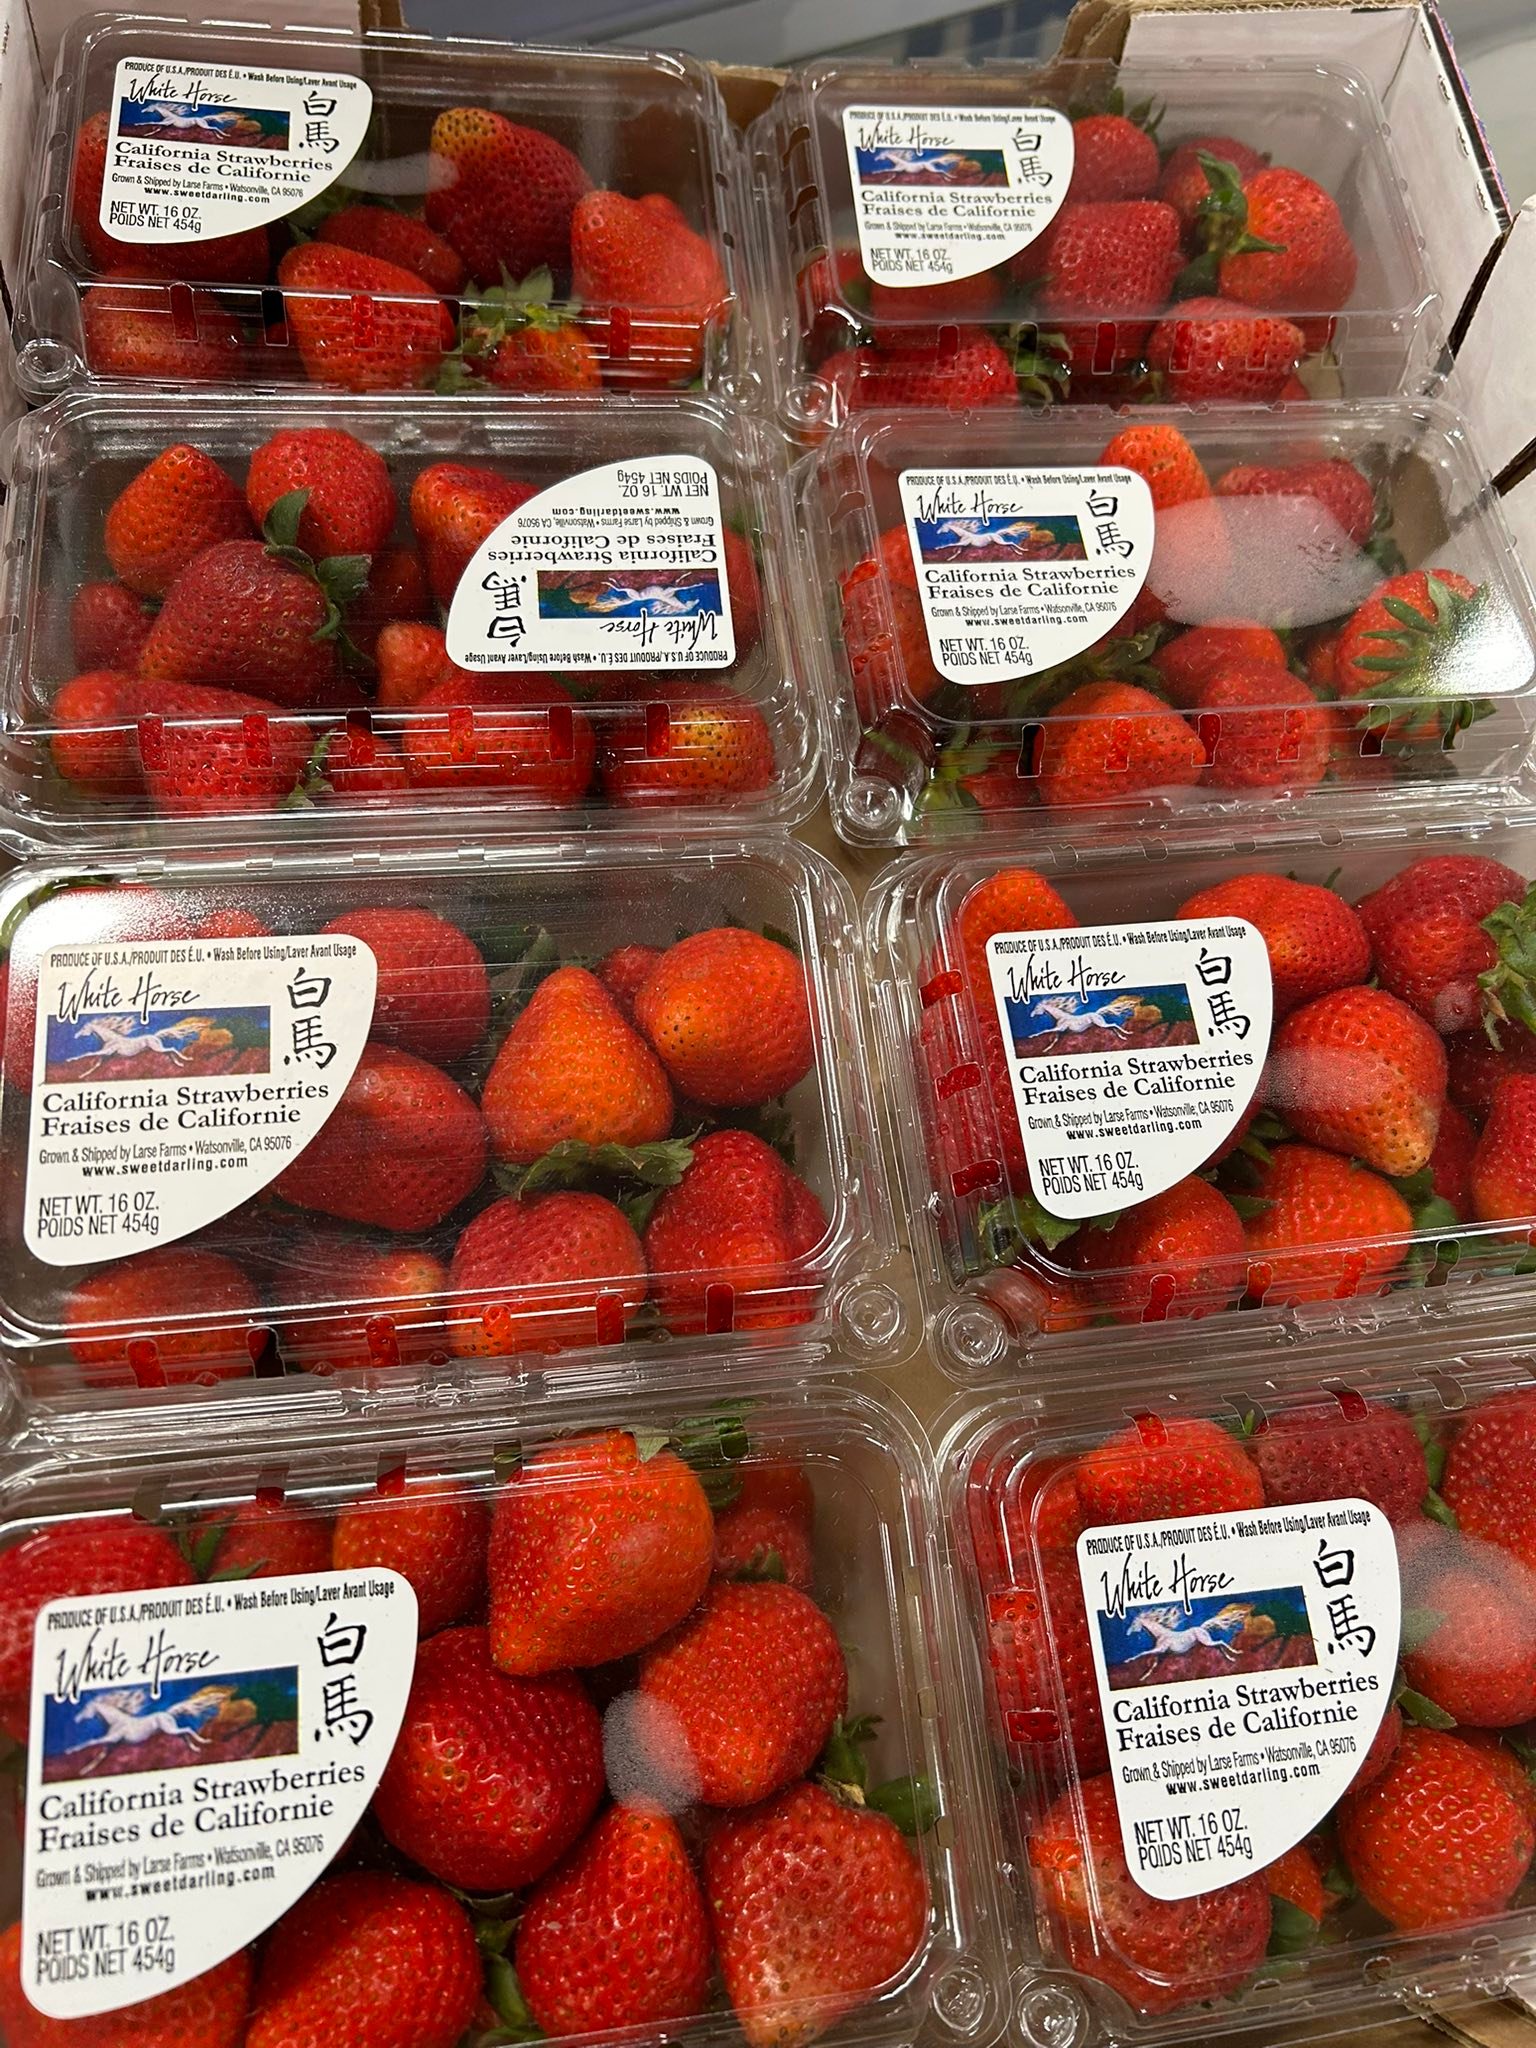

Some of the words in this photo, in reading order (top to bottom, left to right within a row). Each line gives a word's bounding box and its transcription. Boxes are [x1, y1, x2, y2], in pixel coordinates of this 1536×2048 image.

[129, 72, 179, 104] White
[182, 79, 238, 111] Horse
[858, 120, 904, 152] White
[906, 124, 955, 155] Horse
[113, 154, 182, 172] Fraises
[187, 161, 211, 175] de
[216, 163, 312, 183] Californie
[116, 141, 211, 161] California
[216, 149, 334, 172] Strawberries
[144, 184, 270, 204] www.sweetdarling.com
[860, 190, 946, 203] California
[949, 191, 1053, 205] Strawberries
[109, 212, 145, 228] POIDS
[147, 215, 171, 230] NET
[173, 218, 202, 235] 454g
[110, 200, 137, 215] NET
[138, 202, 160, 217] WT.
[163, 205, 179, 218] 16
[182, 206, 202, 220] OZ.
[861, 203, 923, 216] Fraises
[927, 204, 948, 217] de
[952, 204, 1037, 218] Californie
[870, 247, 892, 261] NET
[893, 248, 914, 261] WT.
[916, 248, 931, 261] 16
[932, 248, 952, 261] OZ.
[871, 259, 904, 272] POIDS
[904, 259, 925, 272] NET
[928, 260, 954, 275] 454g
[616, 469, 645, 485] 454g
[648, 472, 671, 485] NET
[673, 471, 708, 485] POIDS
[617, 484, 639, 498] OZ.
[641, 484, 658, 498] 16
[660, 484, 684, 498] WT.
[684, 484, 710, 498] NET
[551, 506, 681, 518] www.sweetdarling.com
[916, 486, 967, 524] White
[970, 489, 1024, 525] Horse
[510, 535, 611, 550] Californie
[616, 535, 641, 549] de
[646, 534, 717, 549] Fraises
[487, 550, 613, 565] Strawberries
[618, 549, 718, 564] California
[924, 568, 1019, 584] California
[1022, 565, 1136, 581] Strawberries
[926, 584, 995, 600] Fraises
[999, 583, 1023, 598] de
[1027, 581, 1119, 597] Californie
[599, 609, 660, 648] Horse
[663, 611, 718, 651] White
[965, 615, 1088, 627] www.sweetdarling.com
[938, 638, 964, 653] NET
[964, 637, 989, 652] WT.
[990, 637, 1007, 651] 16
[1008, 636, 1030, 651] OZ.
[942, 651, 978, 668] POIDS
[978, 651, 1001, 666] NET
[1004, 650, 1034, 667] 454g
[1007, 952, 1063, 1003] White
[1066, 954, 1127, 1002] Horse
[57, 966, 123, 1022] White
[128, 970, 201, 1023] Horse
[1019, 1059, 1124, 1085] California
[1127, 1049, 1254, 1075] Strawberries
[42, 1088, 169, 1114] California
[176, 1080, 329, 1106] Strawberries
[1021, 1084, 1098, 1106] Fraises
[1103, 1080, 1129, 1099] de
[1133, 1071, 1236, 1096] Californie
[40, 1114, 131, 1138] Fraises
[139, 1111, 169, 1132] de
[177, 1104, 301, 1130] Californie
[1066, 1119, 1203, 1141] www.sweetdarling.com
[38, 1149, 70, 1166] Grown
[71, 1147, 80, 1163] &
[81, 1146, 118, 1165] Shipped
[119, 1146, 132, 1163] by
[132, 1144, 158, 1159] Larse
[159, 1142, 187, 1157] Farms
[194, 1138, 247, 1155] Watsonville,
[249, 1137, 263, 1152] CA
[264, 1135, 292, 1151] 95076
[82, 1157, 249, 1178] www.sweetdarling.com
[1038, 1157, 1065, 1178] NET
[1066, 1155, 1094, 1175] WT.
[1095, 1153, 1113, 1172] 16
[1115, 1151, 1139, 1170] OZ.
[1042, 1174, 1082, 1197] POIDS
[1082, 1172, 1108, 1192] NET
[1112, 1170, 1144, 1191] 454g
[38, 1196, 73, 1219] NET
[75, 1194, 103, 1216] WT.
[109, 1193, 129, 1213] 16
[134, 1190, 160, 1212] OZ.
[37, 1216, 84, 1240] POIDS
[89, 1214, 119, 1236] NET
[122, 1212, 160, 1236] 454g
[1085, 1535, 1124, 1556] PRODUCE
[1123, 1534, 1135, 1552] OF
[1196, 1525, 1213, 1543] DES
[1235, 1520, 1259, 1538] Wash
[1257, 1518, 1283, 1536] Before
[1281, 1514, 1326, 1534] Using/Laver
[1326, 1510, 1348, 1528] Avant
[1346, 1509, 1371, 1527] Usage
[1100, 1551, 1164, 1617] White
[1167, 1552, 1235, 1613] Horse
[56, 1627, 131, 1701] White
[136, 1628, 219, 1697] Horse
[1112, 1688, 1231, 1723] California
[1235, 1670, 1379, 1707] Strawberries
[1115, 1722, 1201, 1752] Fraises
[1207, 1715, 1237, 1739] de
[1242, 1699, 1358, 1734] Californie
[39, 1782, 184, 1822] California
[193, 1761, 366, 1803] Strawberries
[1165, 1763, 1321, 1796] www.sweetdarling.com
[37, 1821, 141, 1855] Fraises
[150, 1812, 185, 1839] de
[194, 1793, 334, 1833] Californie
[1133, 1818, 1164, 1846] NET
[1165, 1814, 1196, 1840] WT.
[1198, 1811, 1218, 1835] 16
[1221, 1807, 1248, 1833] OZ.
[1137, 1841, 1183, 1871] POIDS
[1183, 1836, 1212, 1863] NET
[1217, 1833, 1253, 1860] 454g
[85, 1865, 275, 1903] www.sweetdarling.com
[36, 1929, 75, 1960] NET
[78, 1924, 110, 1954] WT.
[117, 1920, 140, 1948] 16
[145, 1915, 175, 1944] OZ.
[36, 1954, 89, 1989] POIDS
[94, 1949, 128, 1979] NET
[132, 1944, 175, 1975] 454g
